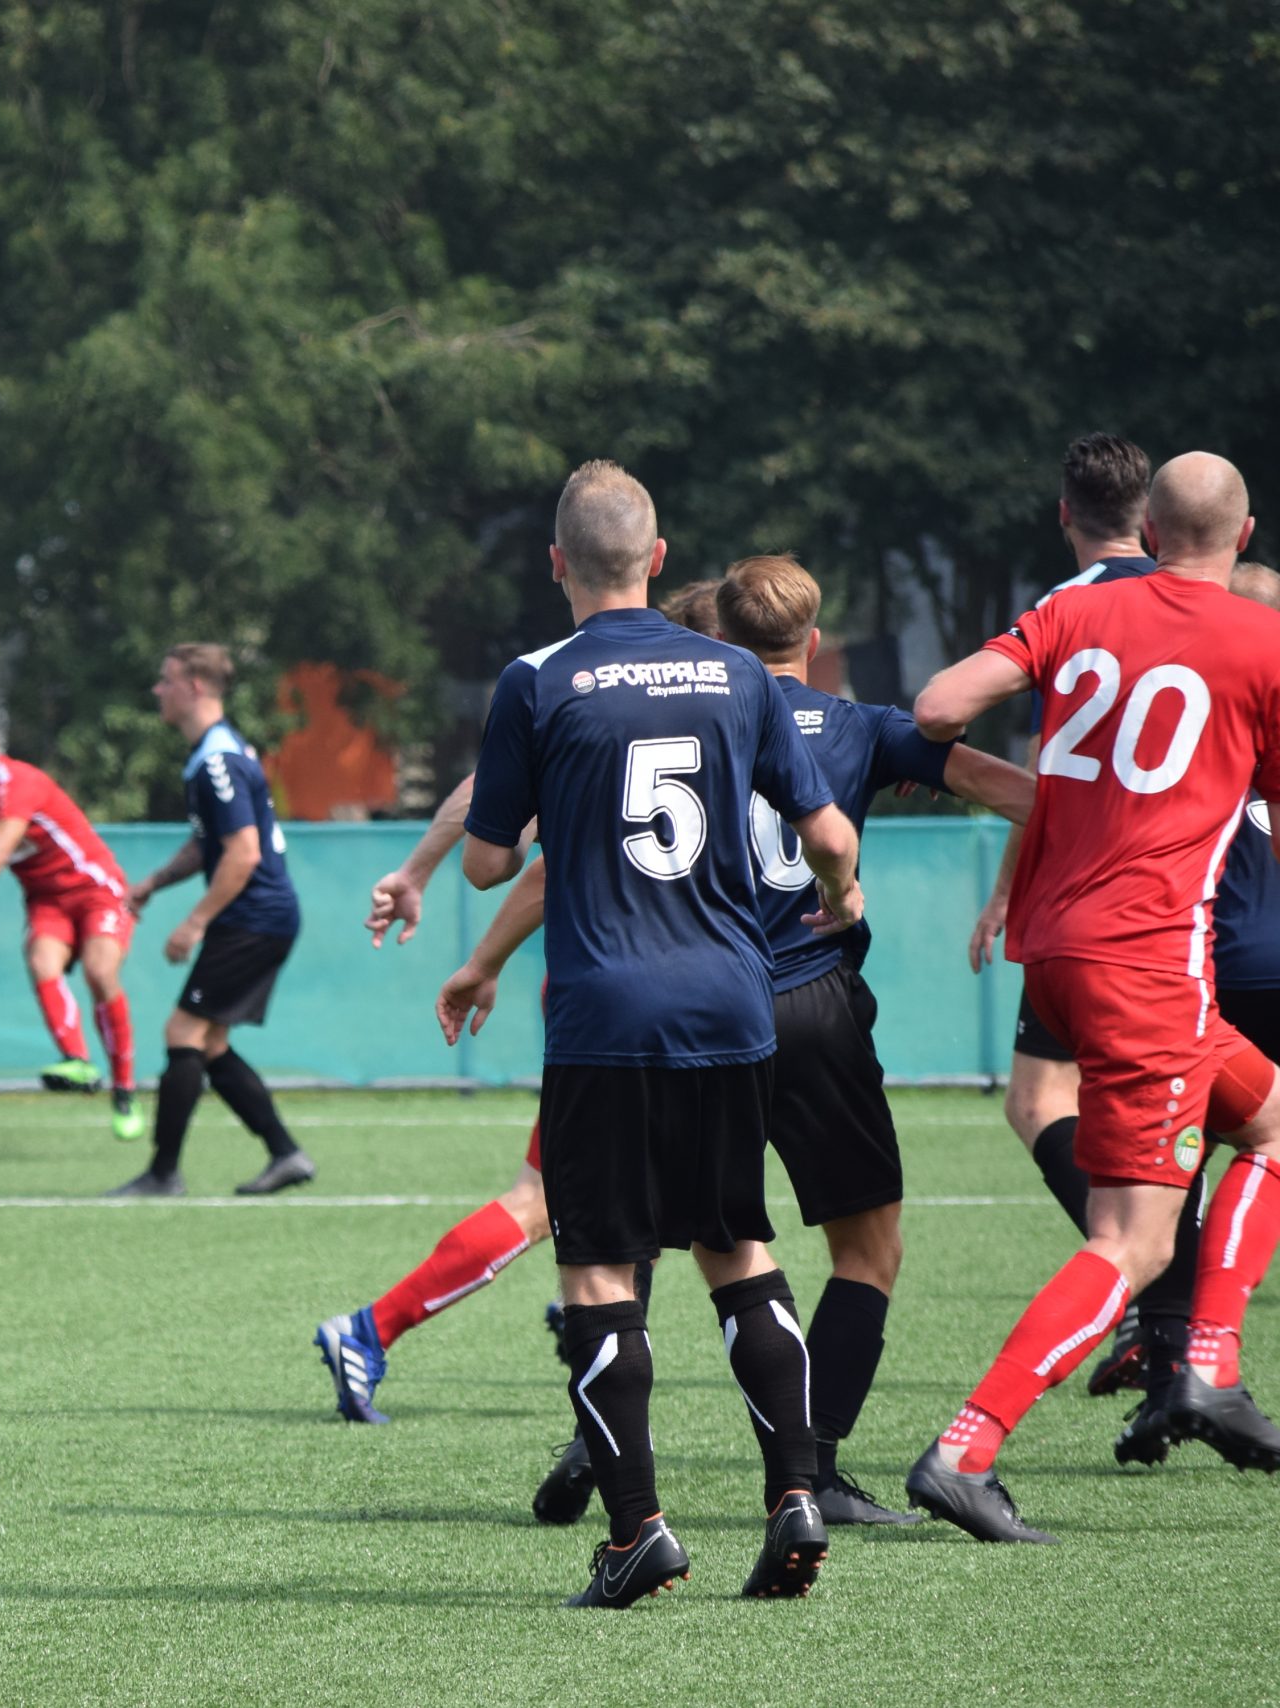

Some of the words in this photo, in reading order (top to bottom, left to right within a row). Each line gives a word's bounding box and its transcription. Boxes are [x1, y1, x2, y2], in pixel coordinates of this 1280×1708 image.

[595, 661, 728, 688] SPORTPALEIS
[1038, 648, 1211, 794] 20
[622, 736, 707, 881] 5
